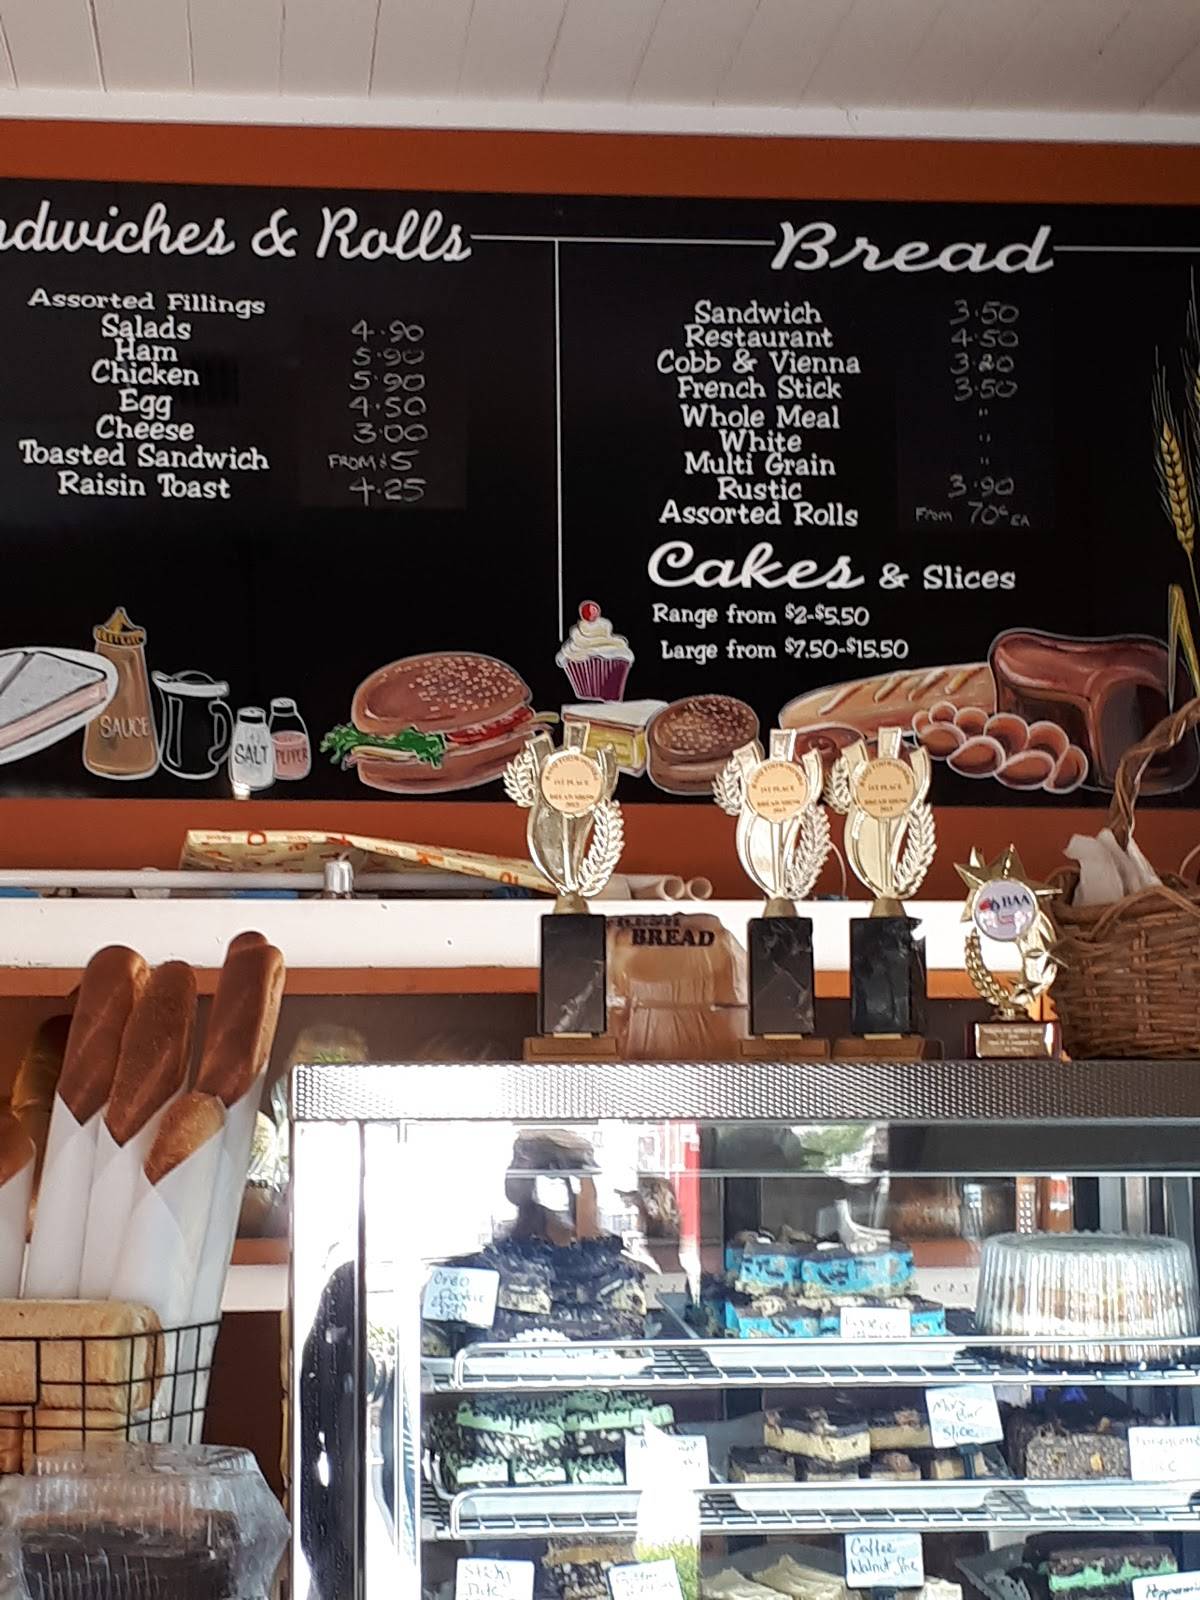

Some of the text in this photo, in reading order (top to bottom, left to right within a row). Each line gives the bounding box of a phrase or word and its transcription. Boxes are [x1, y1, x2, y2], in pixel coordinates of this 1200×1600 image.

[251, 207, 298, 258] &
[315, 206, 472, 262] Rolls
[770, 221, 1055, 273] Bread
[27, 288, 266, 321] Assorted Fillings
[694, 299, 823, 326] Sandwich
[101, 313, 192, 341] Salads
[351, 319, 424, 343] 4.90
[684, 323, 834, 349] Restaurant
[114, 337, 178, 362] Ham
[656, 348, 861, 375] Cobb & Vienna
[90, 359, 200, 387] Chicken
[677, 374, 842, 400] French Stick
[118, 387, 173, 420] Egg
[680, 403, 840, 430] Whole Meal
[95, 413, 195, 441] Cheese
[18, 438, 270, 471] Toasted Sandwich
[718, 428, 802, 454] White
[684, 450, 836, 477] Multi Grain
[57, 470, 232, 499] Raisin Toast
[717, 475, 803, 501] Rustic
[658, 499, 859, 528] Assorted Rolls
[647, 540, 1016, 591] Cakes & Slices
[652, 602, 718, 630] Range
[726, 603, 777, 625] from
[660, 638, 909, 665] Large from $7.50-$15.50
[100, 714, 150, 739] SAUCE
[235, 743, 269, 767] SALT
[632, 928, 715, 948] BREAD
[850, 1536, 897, 1557] Coffee
